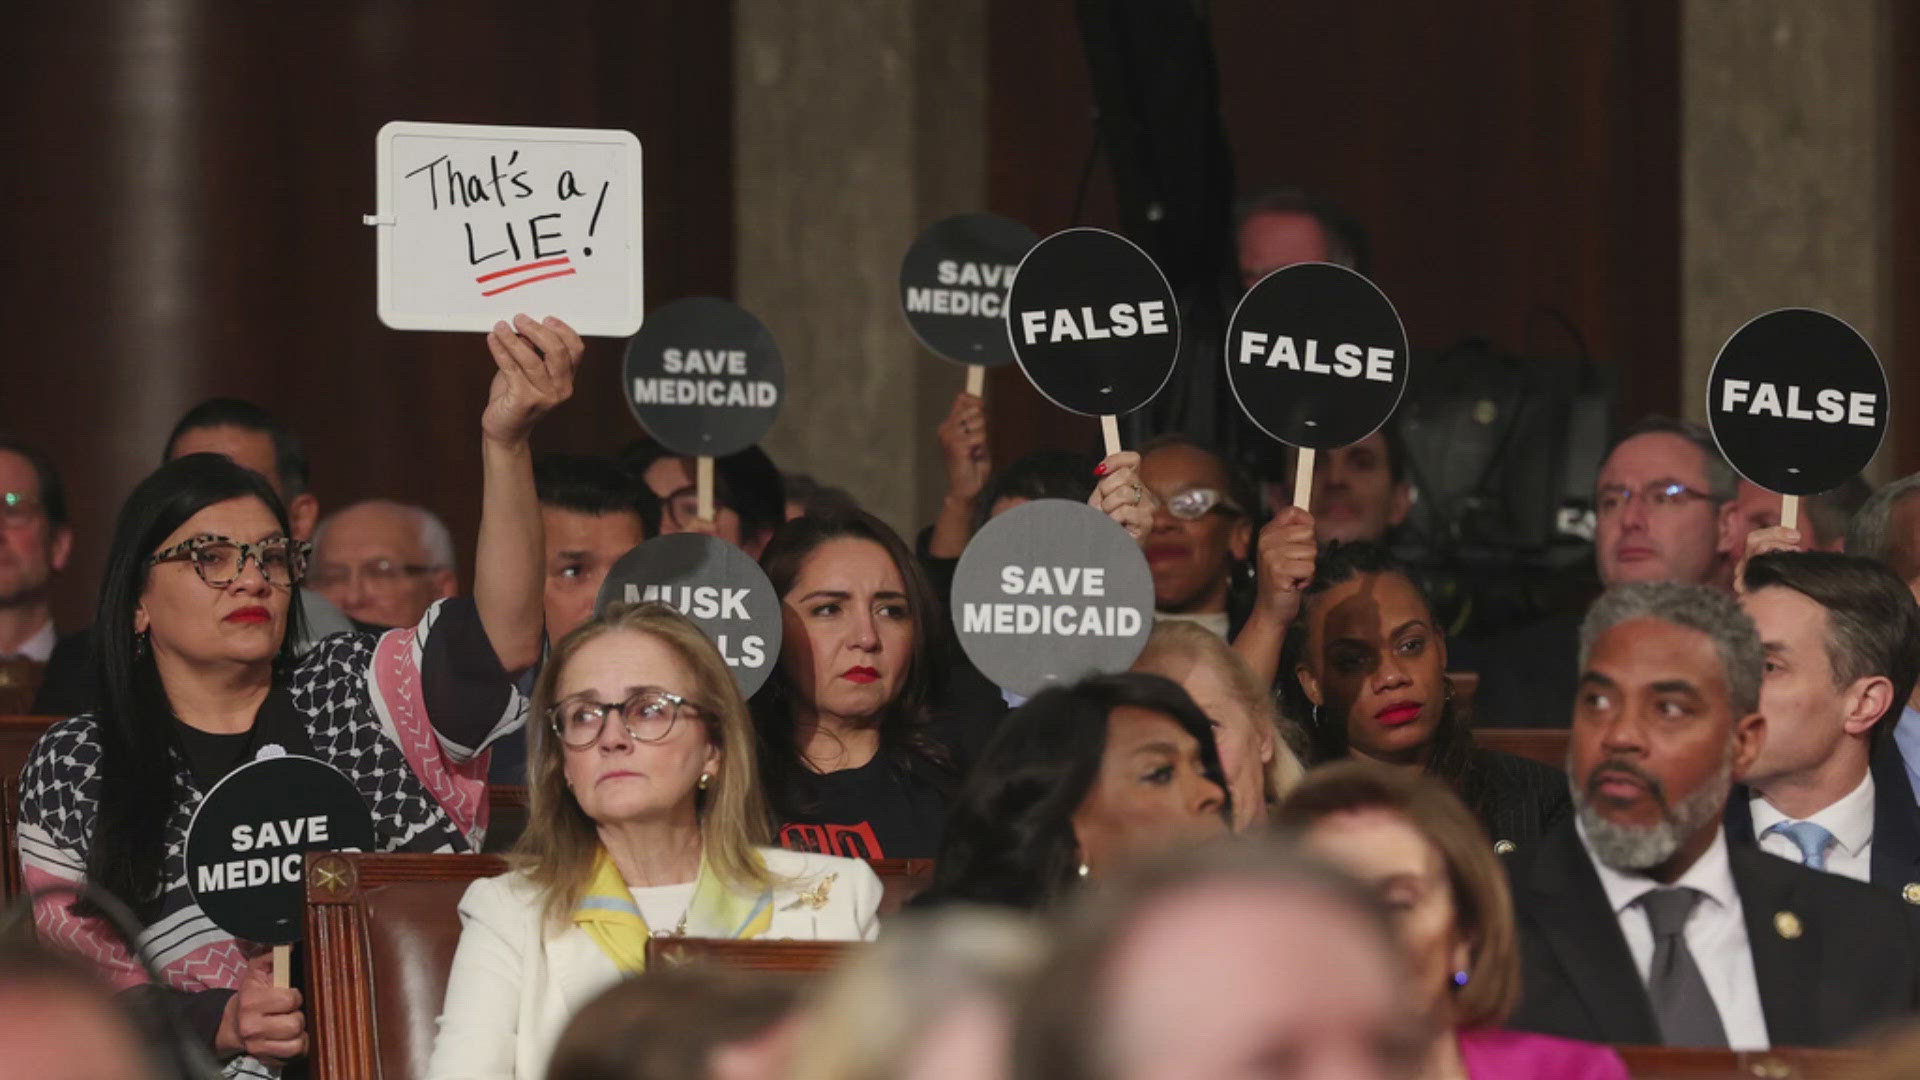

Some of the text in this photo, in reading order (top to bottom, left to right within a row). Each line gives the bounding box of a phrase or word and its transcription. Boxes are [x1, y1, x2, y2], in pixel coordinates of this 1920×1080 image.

[405, 149, 586, 210] That's a
[464, 181, 609, 265] LIE!
[906, 286, 1010, 319] MEDIC
[1021, 300, 1169, 345] FALSE
[662, 347, 747, 375] SAVE
[1239, 330, 1395, 383] FALSE
[633, 377, 778, 408] MEDICAID
[1722, 378, 1877, 427] FALSE
[1000, 565, 1105, 597] SAVE
[963, 603, 1142, 637] MEDICAID
[231, 815, 329, 852] SAVE
[197, 847, 362, 893] MEDIC
